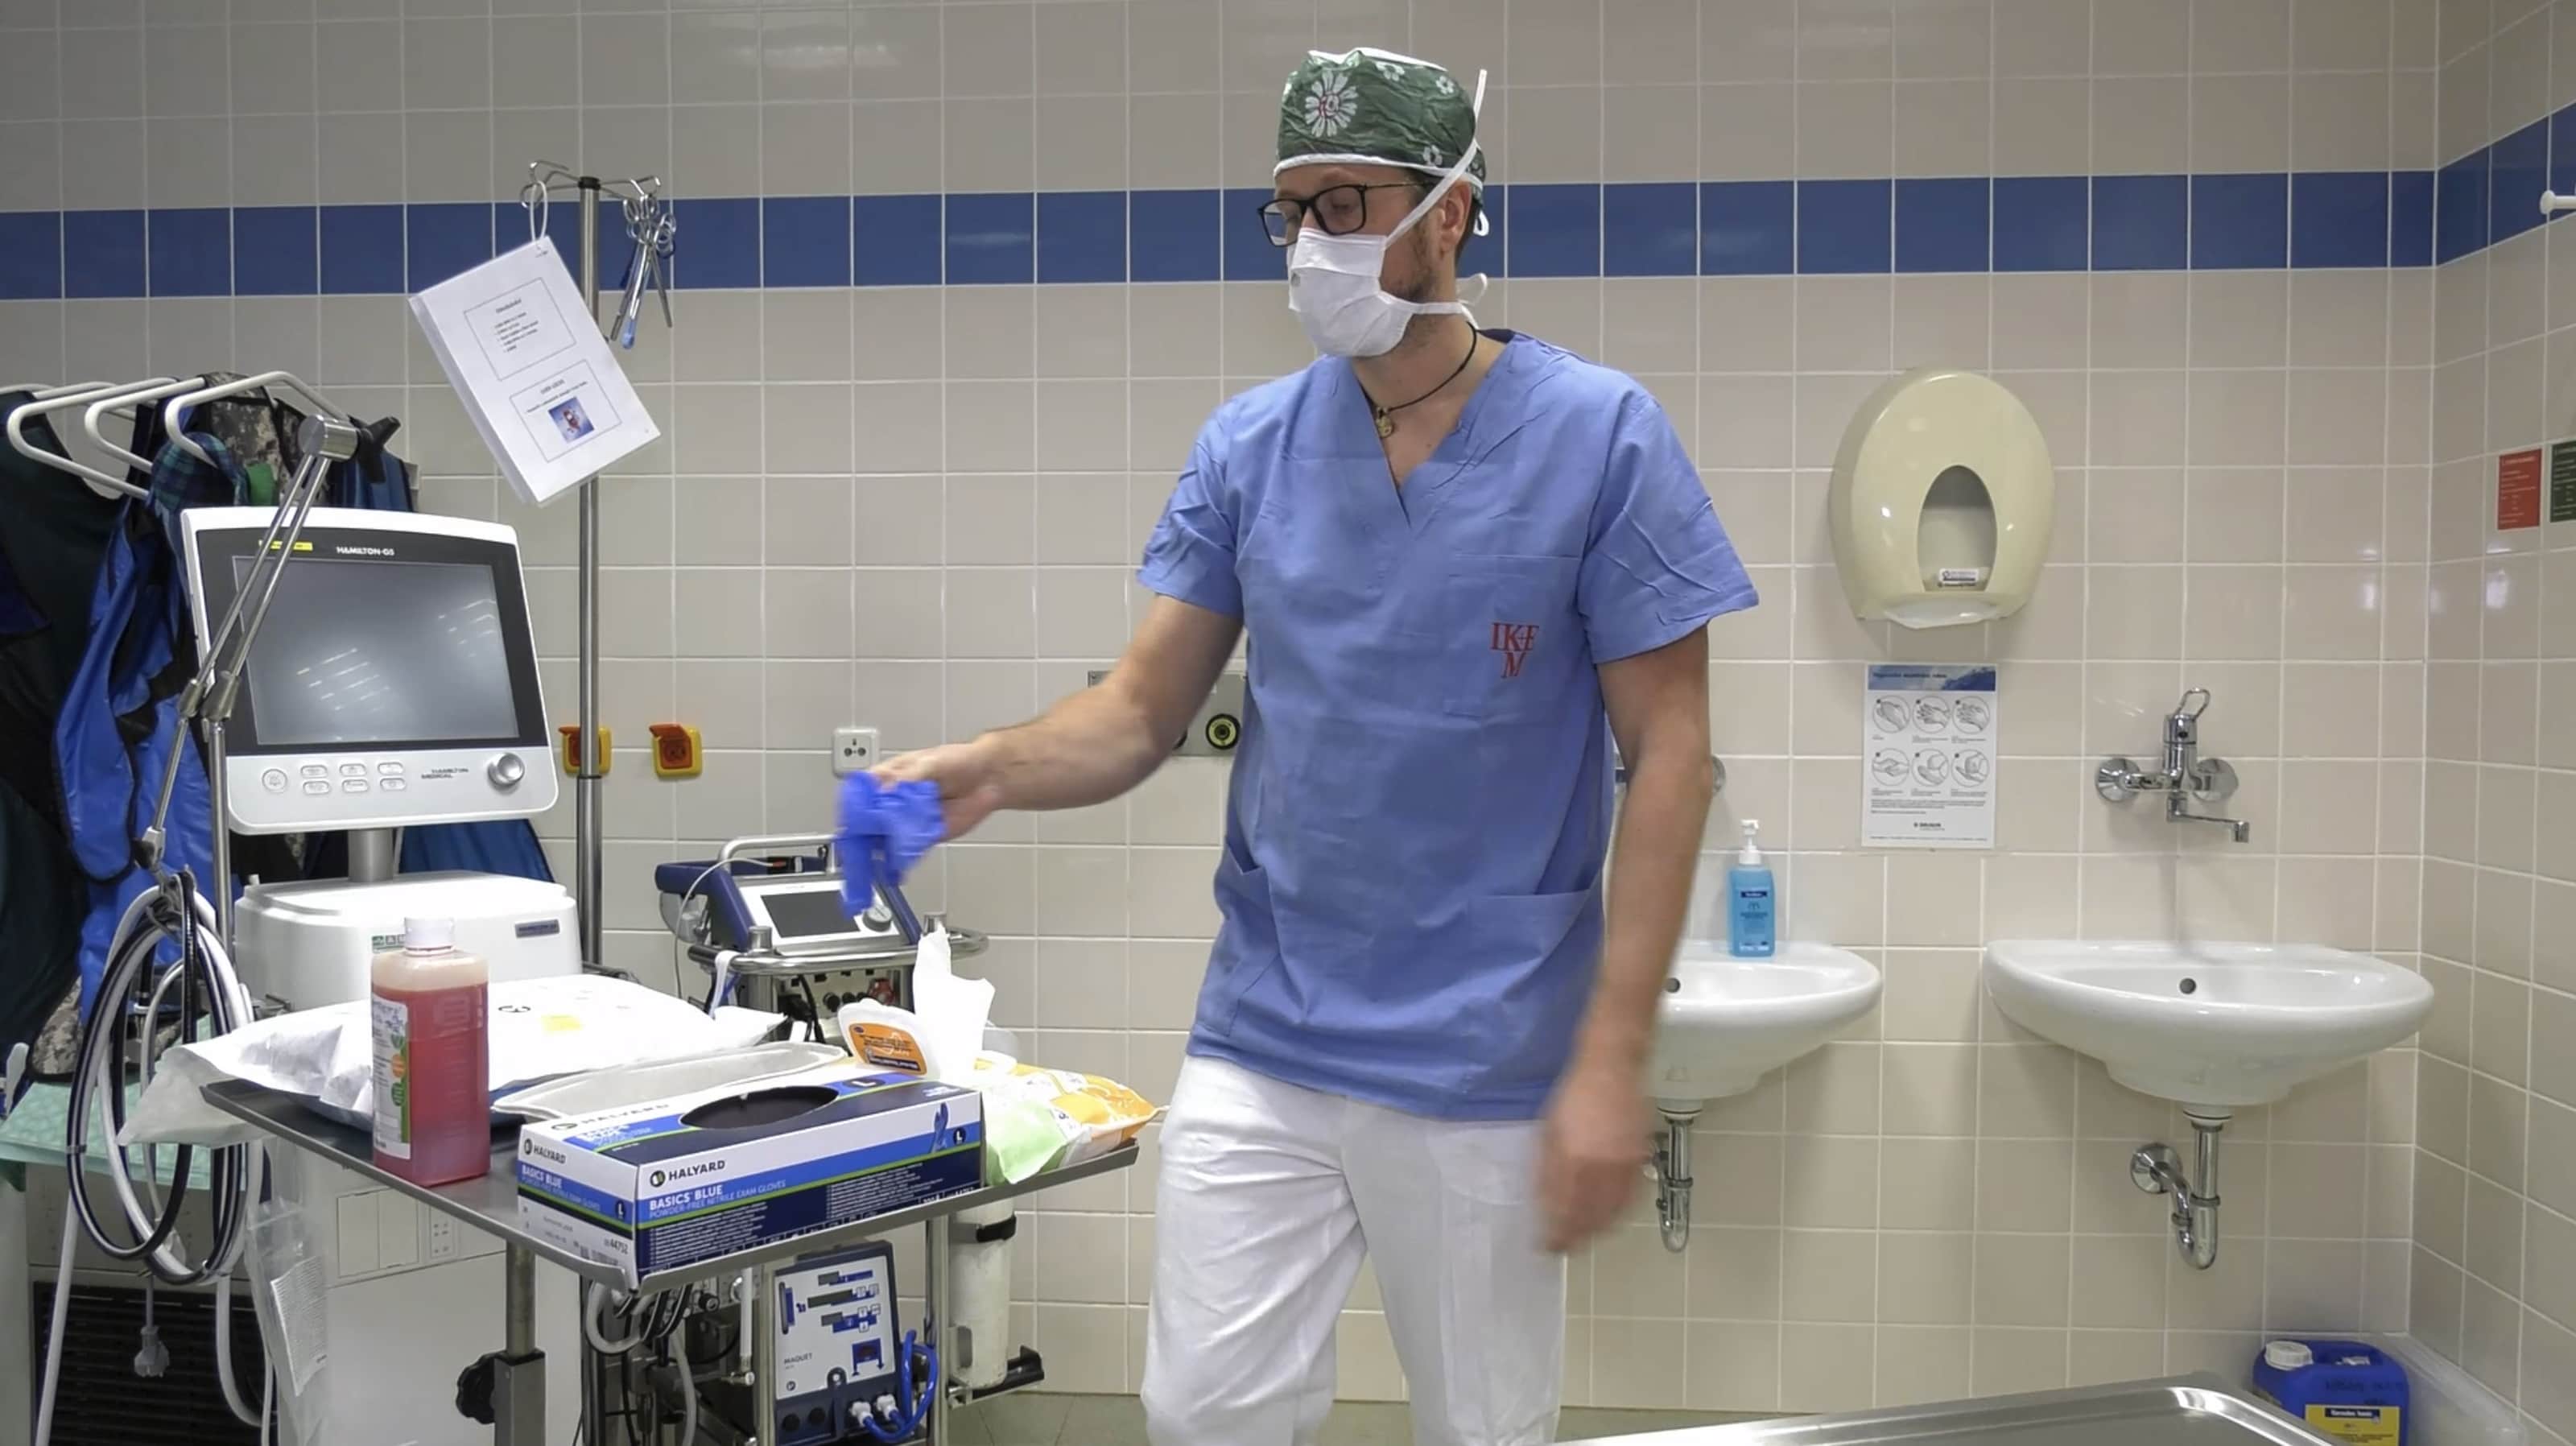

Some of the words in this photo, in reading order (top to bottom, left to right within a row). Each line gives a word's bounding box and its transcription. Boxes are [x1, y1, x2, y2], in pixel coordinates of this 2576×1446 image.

[956, 1130, 964, 1142] L
[533, 1145, 566, 1164] HALYARD
[522, 1163, 544, 1181] BASICS
[545, 1173, 563, 1189] BLUE
[669, 1159, 726, 1182] HALYARD
[649, 1192, 691, 1212] BASICS
[694, 1184, 724, 1200] BLUE
[706, 1192, 735, 1207] NITRILE
[736, 1187, 757, 1197] EXAM
[758, 1179, 786, 1193] GLOVES
[617, 1202, 624, 1216] L
